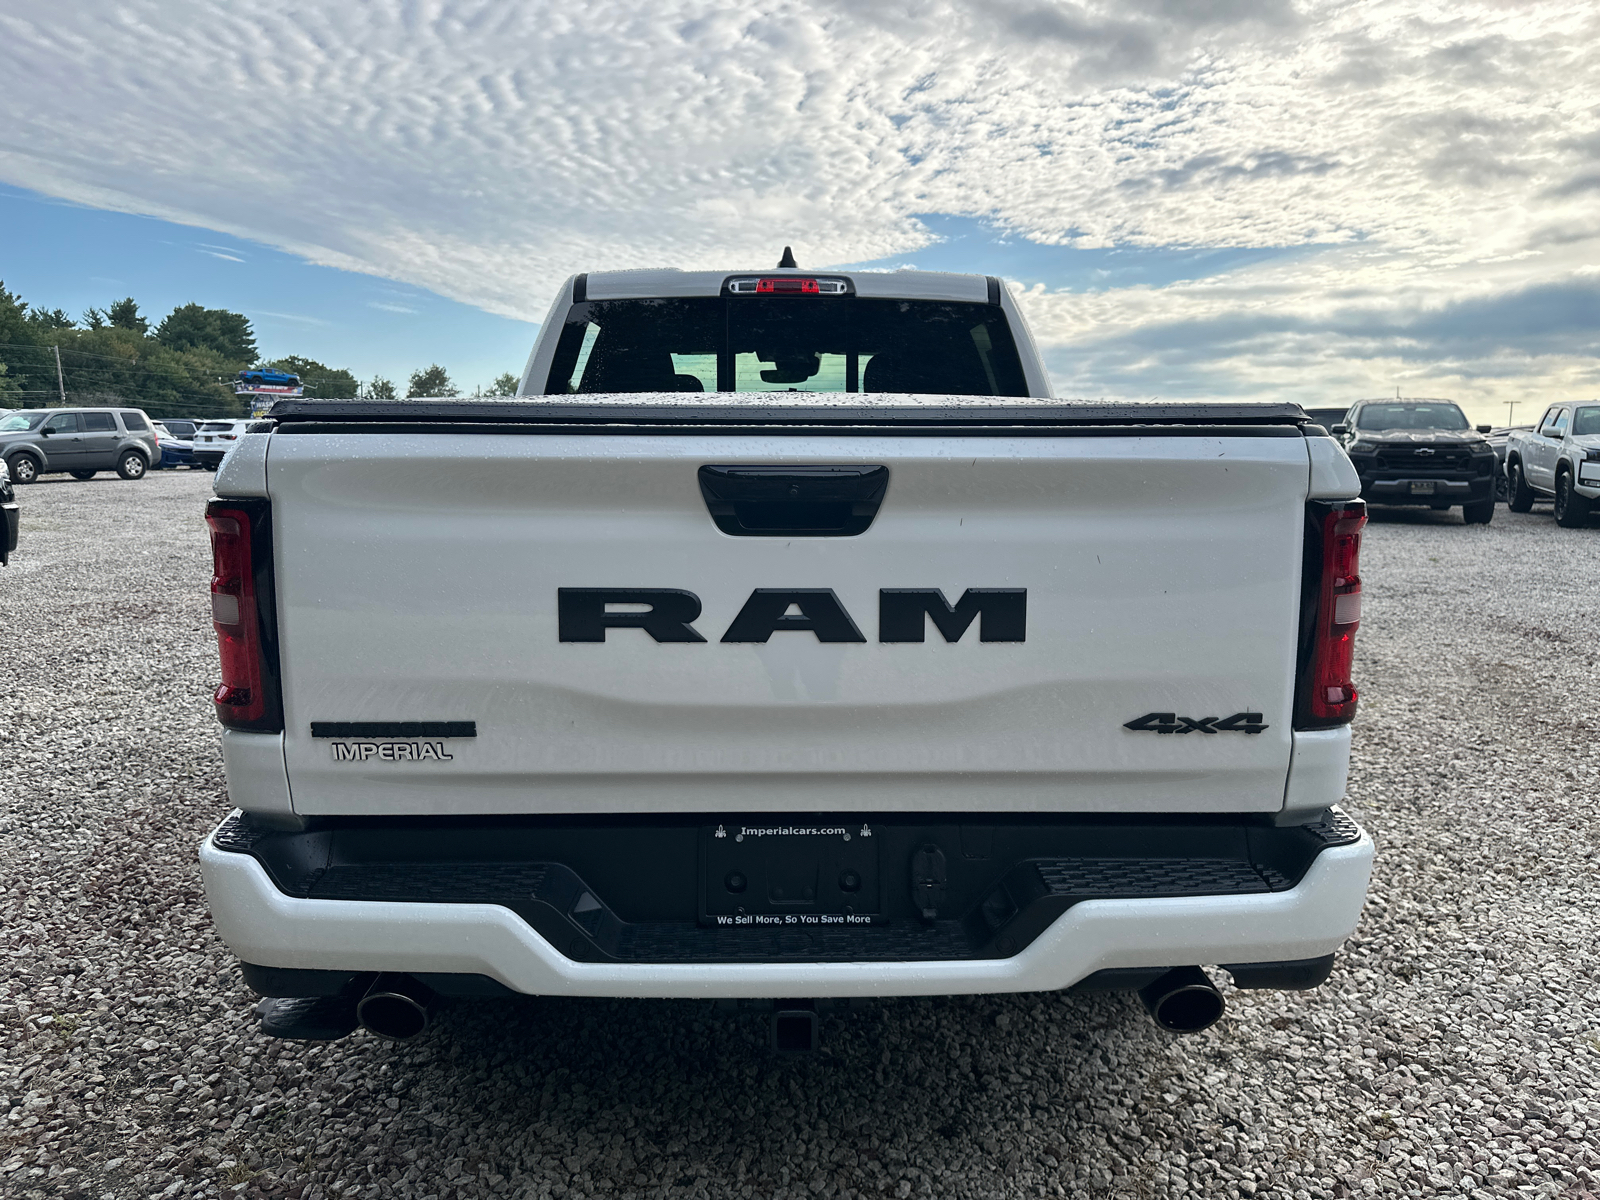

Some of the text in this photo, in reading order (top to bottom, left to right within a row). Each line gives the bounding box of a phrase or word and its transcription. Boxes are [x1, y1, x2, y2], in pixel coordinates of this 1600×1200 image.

[558, 587, 1027, 643] RAM
[1123, 712, 1269, 734] 4x4
[331, 742, 453, 760] IMPERIAL
[741, 826, 846, 837] Imperialcars.com
[717, 915, 871, 925] We Sell More, So You Save More
